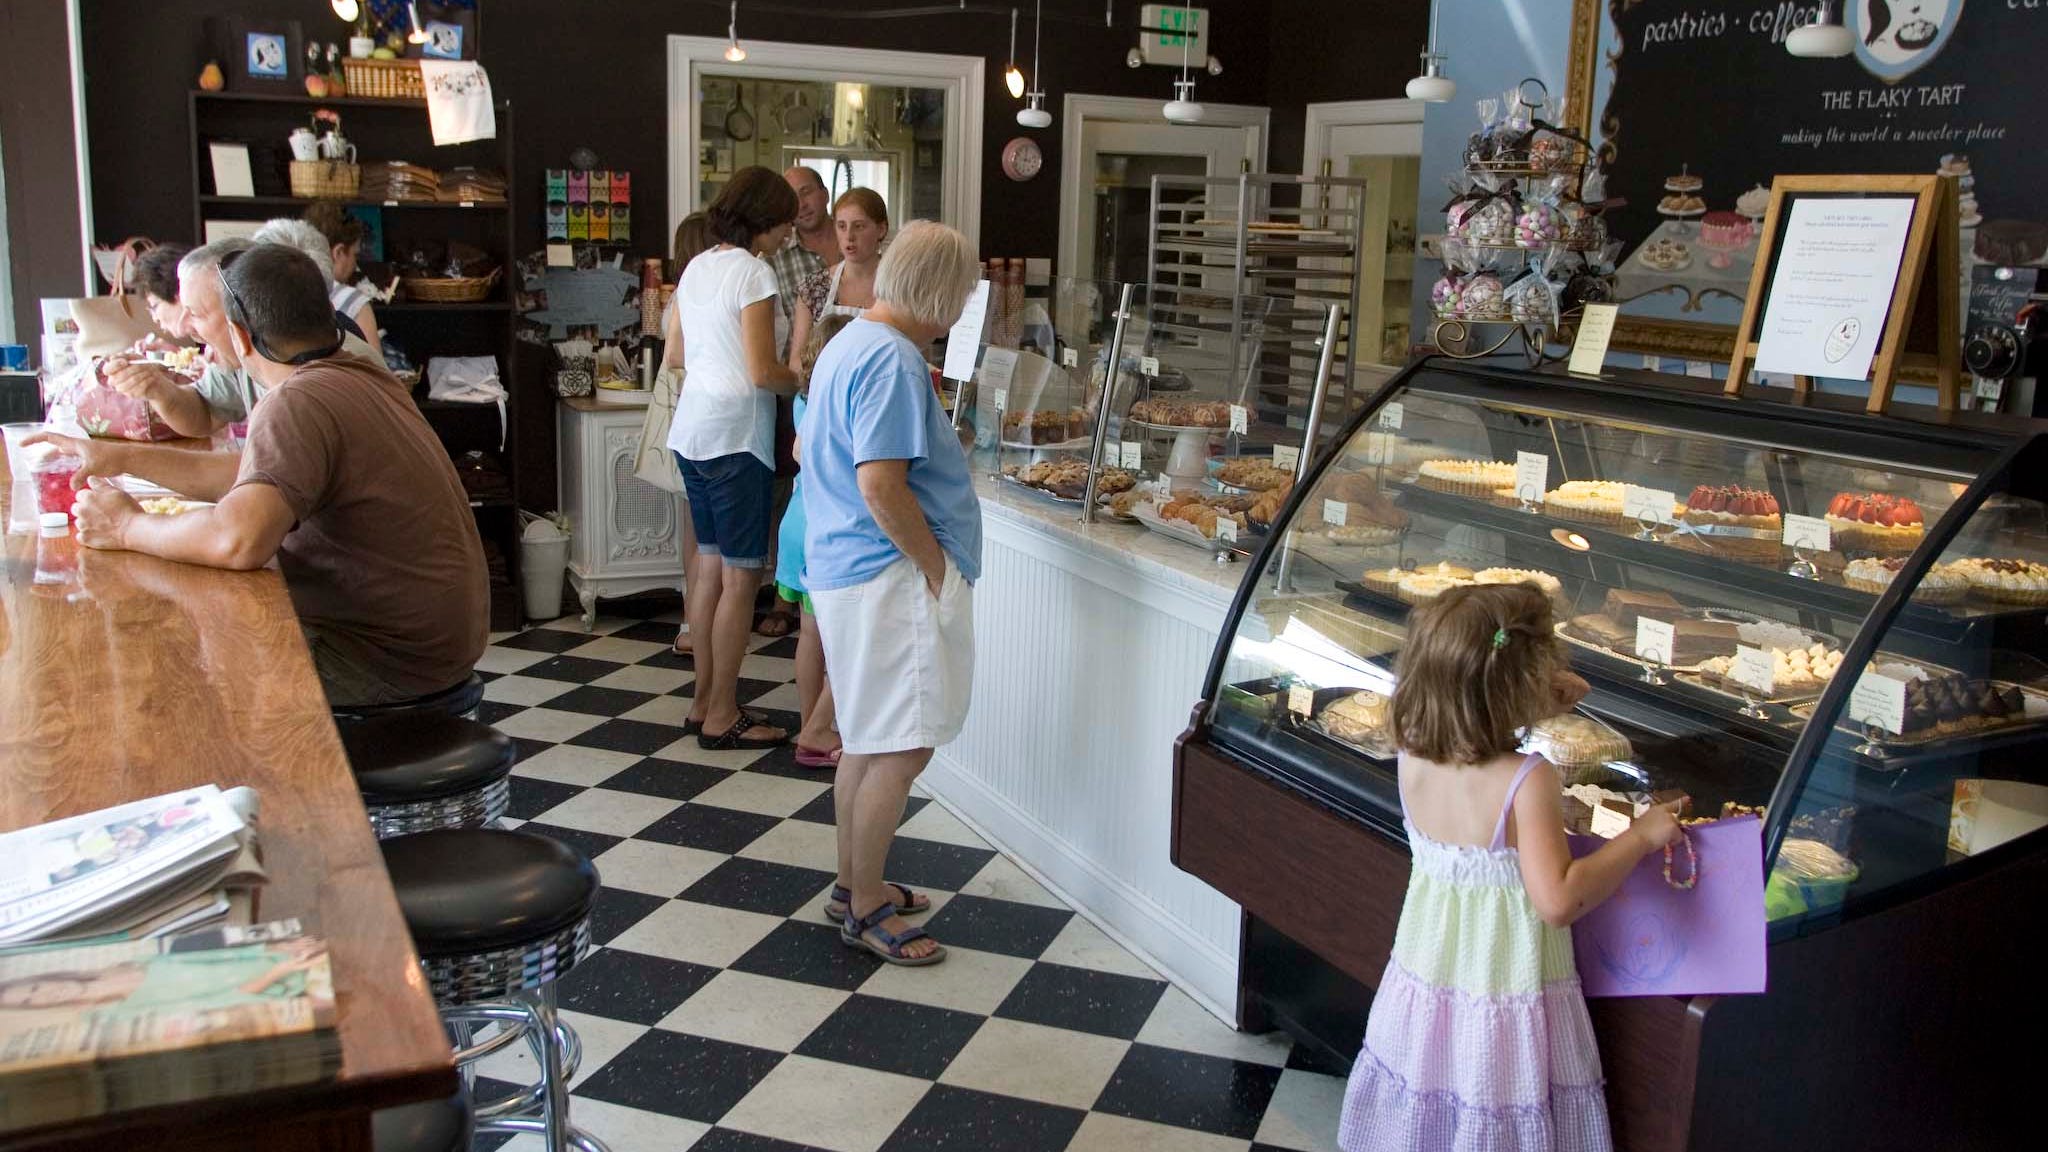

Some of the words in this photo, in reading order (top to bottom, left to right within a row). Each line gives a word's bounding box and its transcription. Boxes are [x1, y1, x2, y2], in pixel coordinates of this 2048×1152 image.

[1642, 11, 1726, 52] pastries
[1750, 1, 1816, 43] coffee
[1821, 90, 1851, 110] THE
[1857, 87, 1913, 109] FLAKY
[1918, 84, 1966, 107] TART
[1781, 128, 1822, 149] making
[1826, 126, 1846, 143] the
[1850, 125, 1890, 142] world
[1893, 129, 1901, 141] a
[1907, 123, 1963, 142] sweeter
[1965, 122, 2006, 145] place
